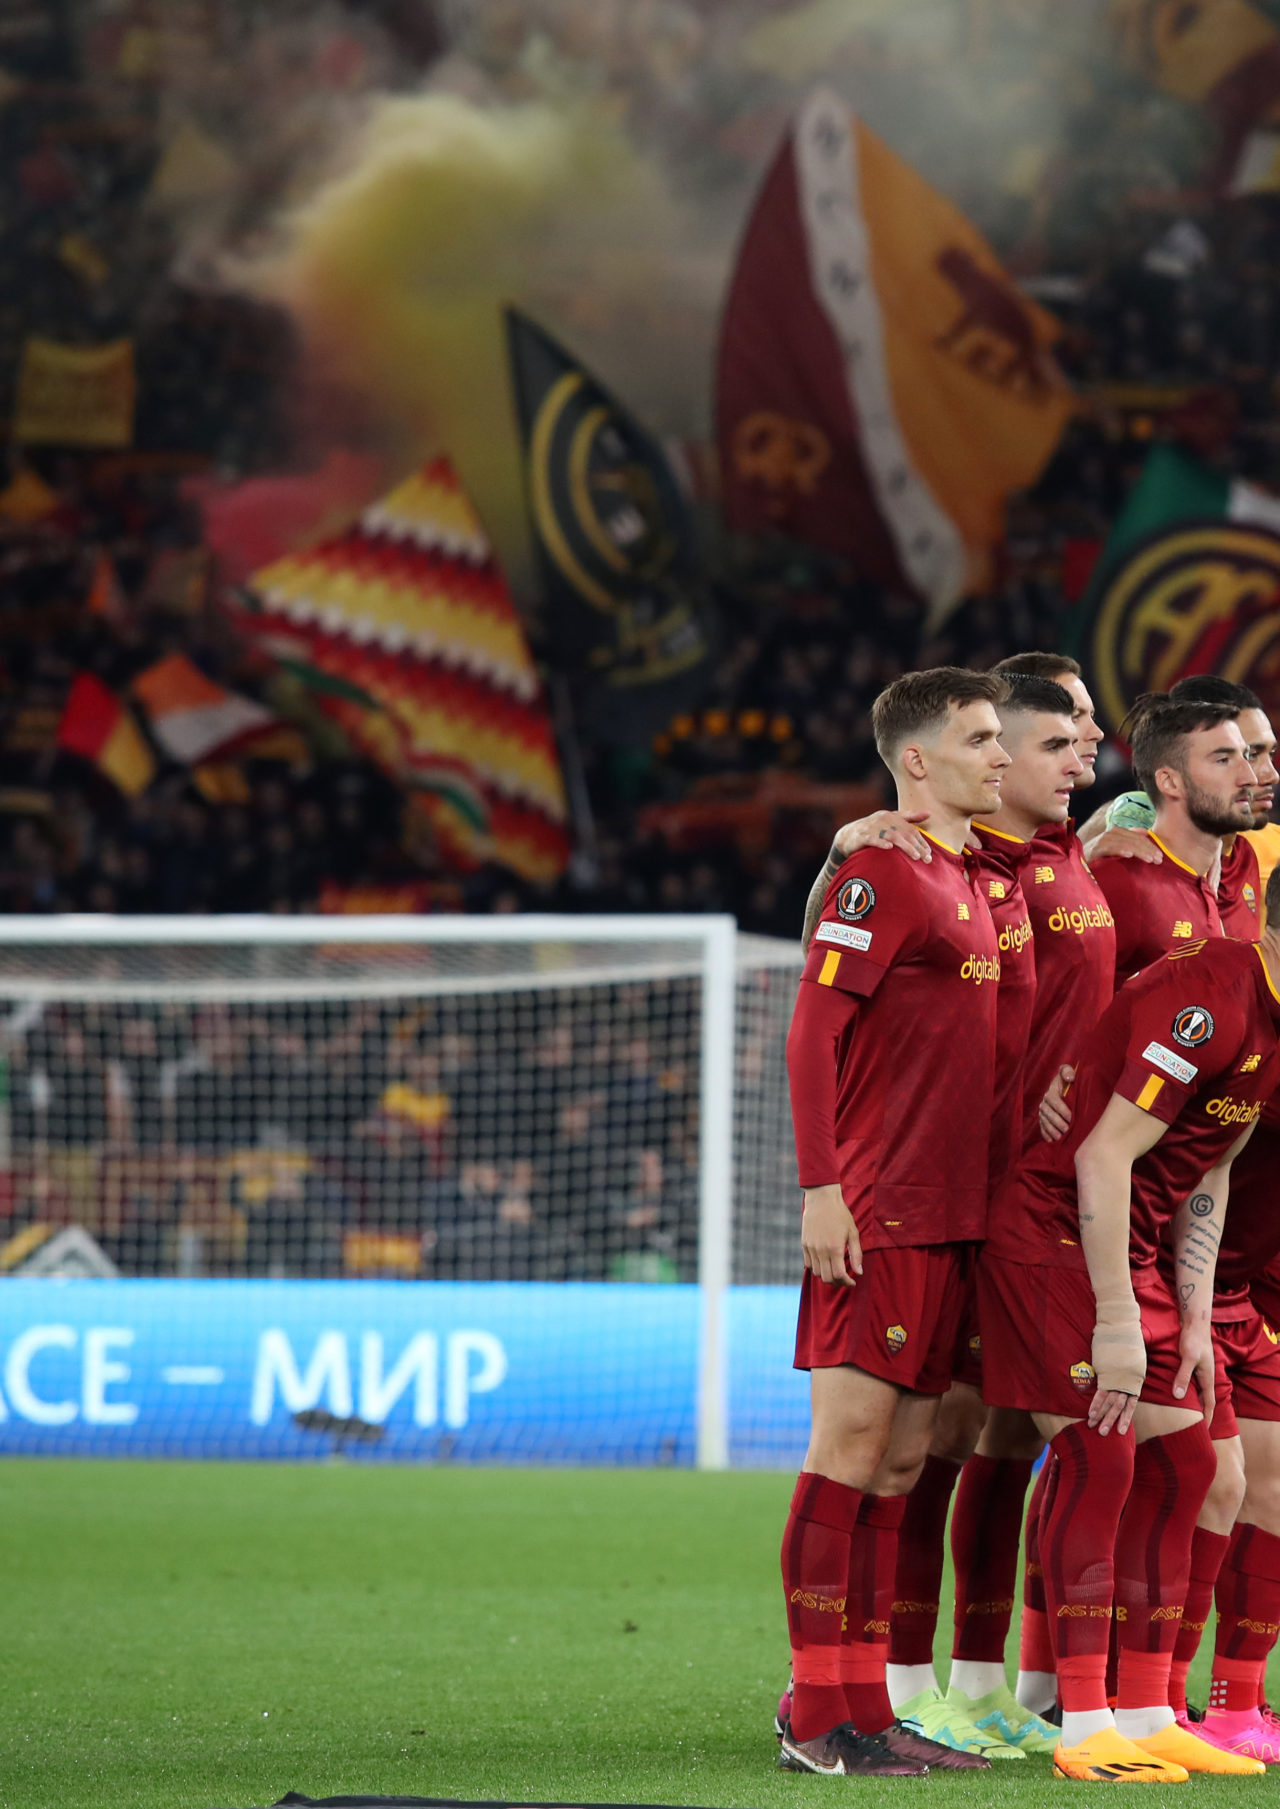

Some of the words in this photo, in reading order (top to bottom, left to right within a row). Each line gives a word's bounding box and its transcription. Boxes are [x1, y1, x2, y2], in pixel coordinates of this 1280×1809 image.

[819, 927, 869, 944] FOUNDATION
[1147, 1046, 1193, 1078] FOUNDATION
[1073, 1377, 1092, 1386] ROMA
